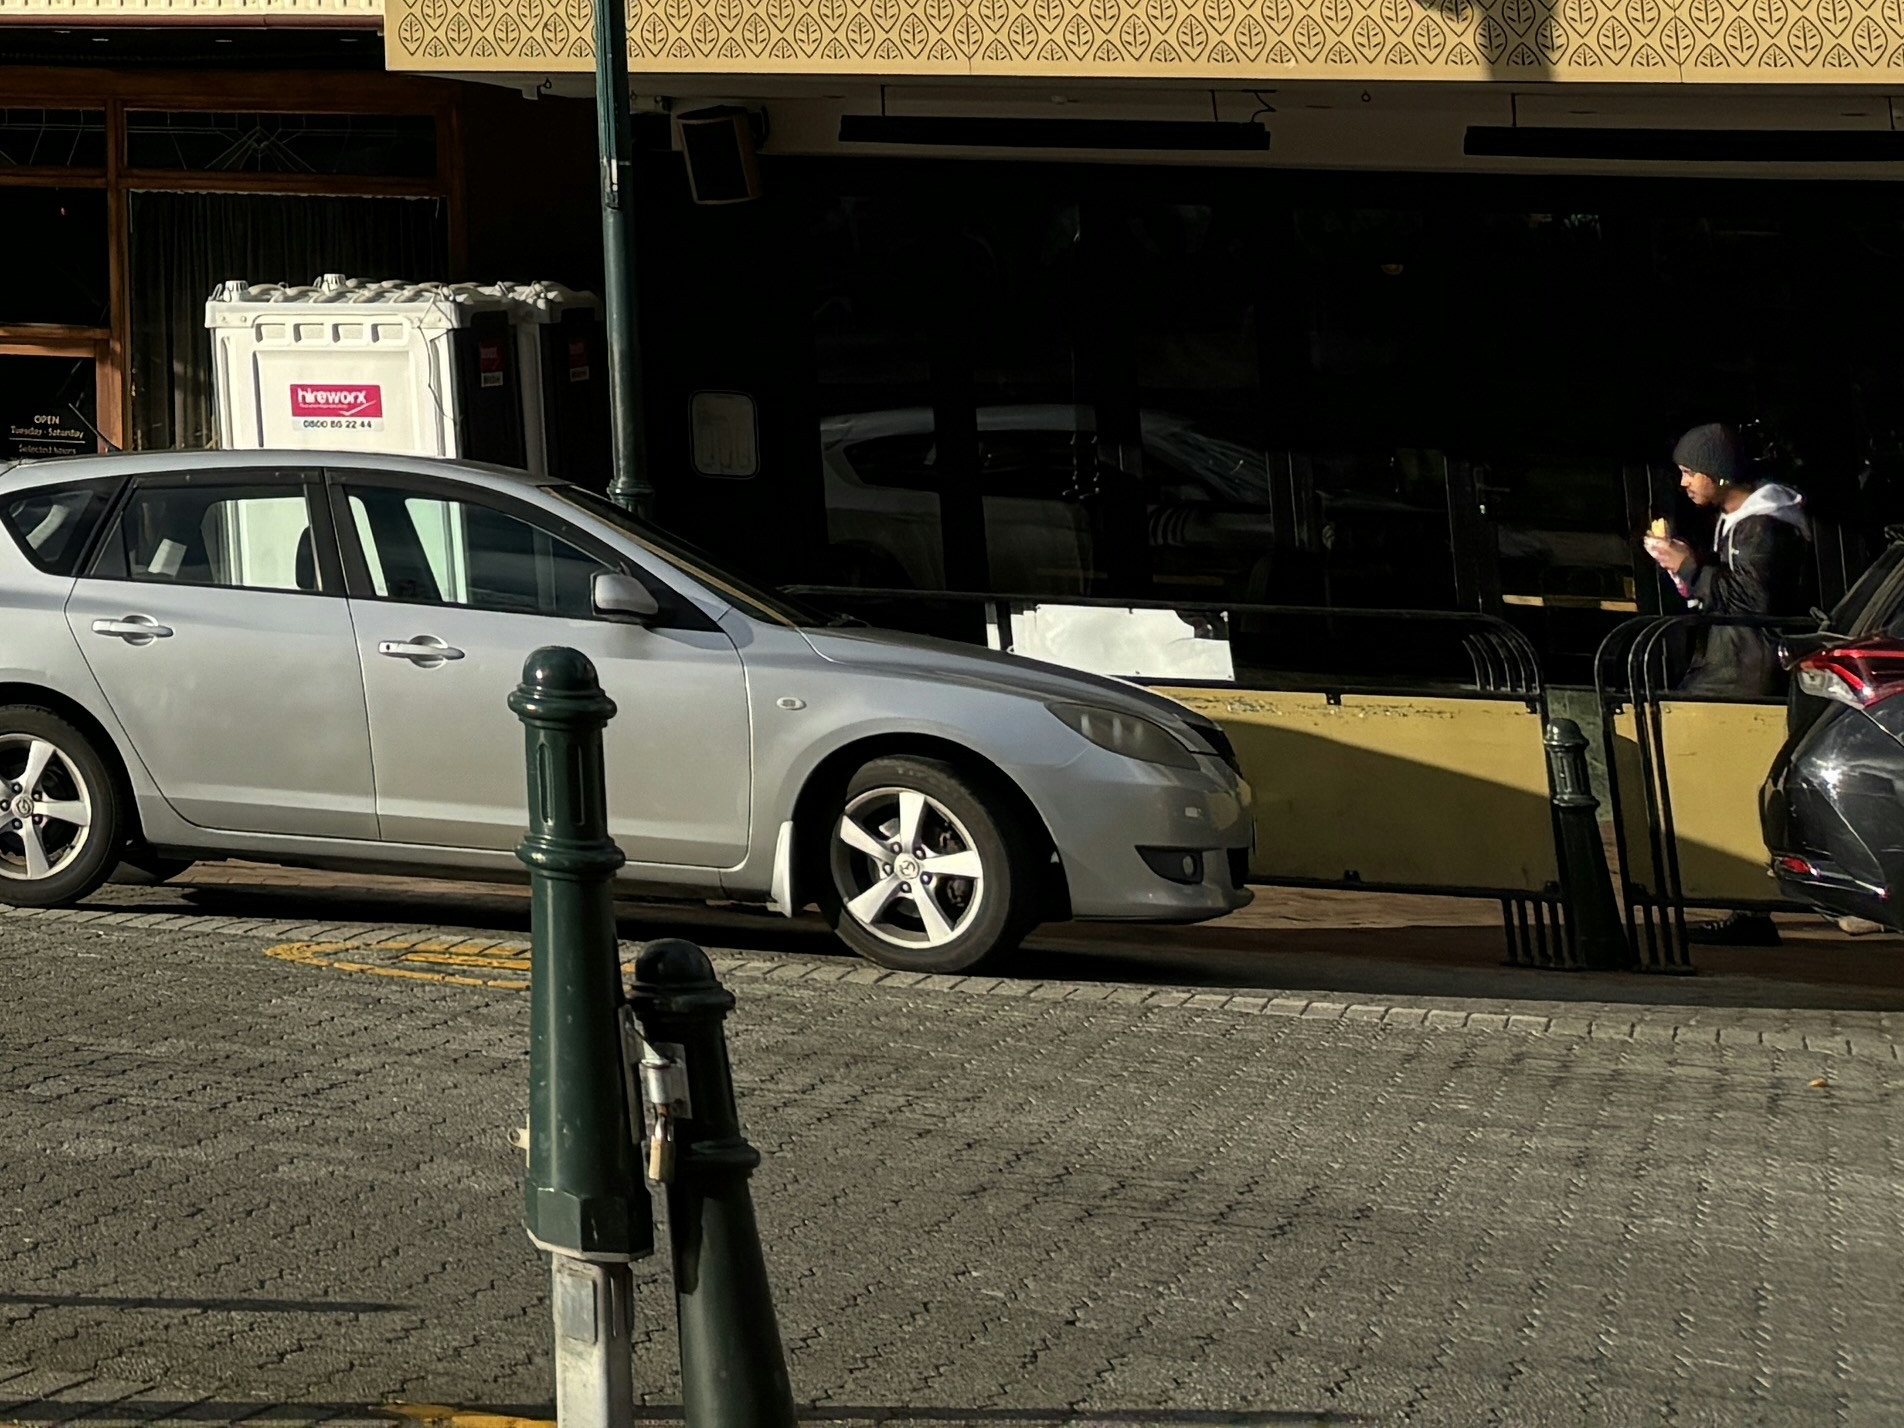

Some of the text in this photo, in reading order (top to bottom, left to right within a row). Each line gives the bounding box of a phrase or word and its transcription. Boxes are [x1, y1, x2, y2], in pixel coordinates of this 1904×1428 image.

[297, 387, 367, 405] hireworx
[33, 414, 60, 425] OPEN
[344, 420, 357, 430] 22
[10, 425, 43, 437] Tuesday
[48, 427, 85, 440] Saturday
